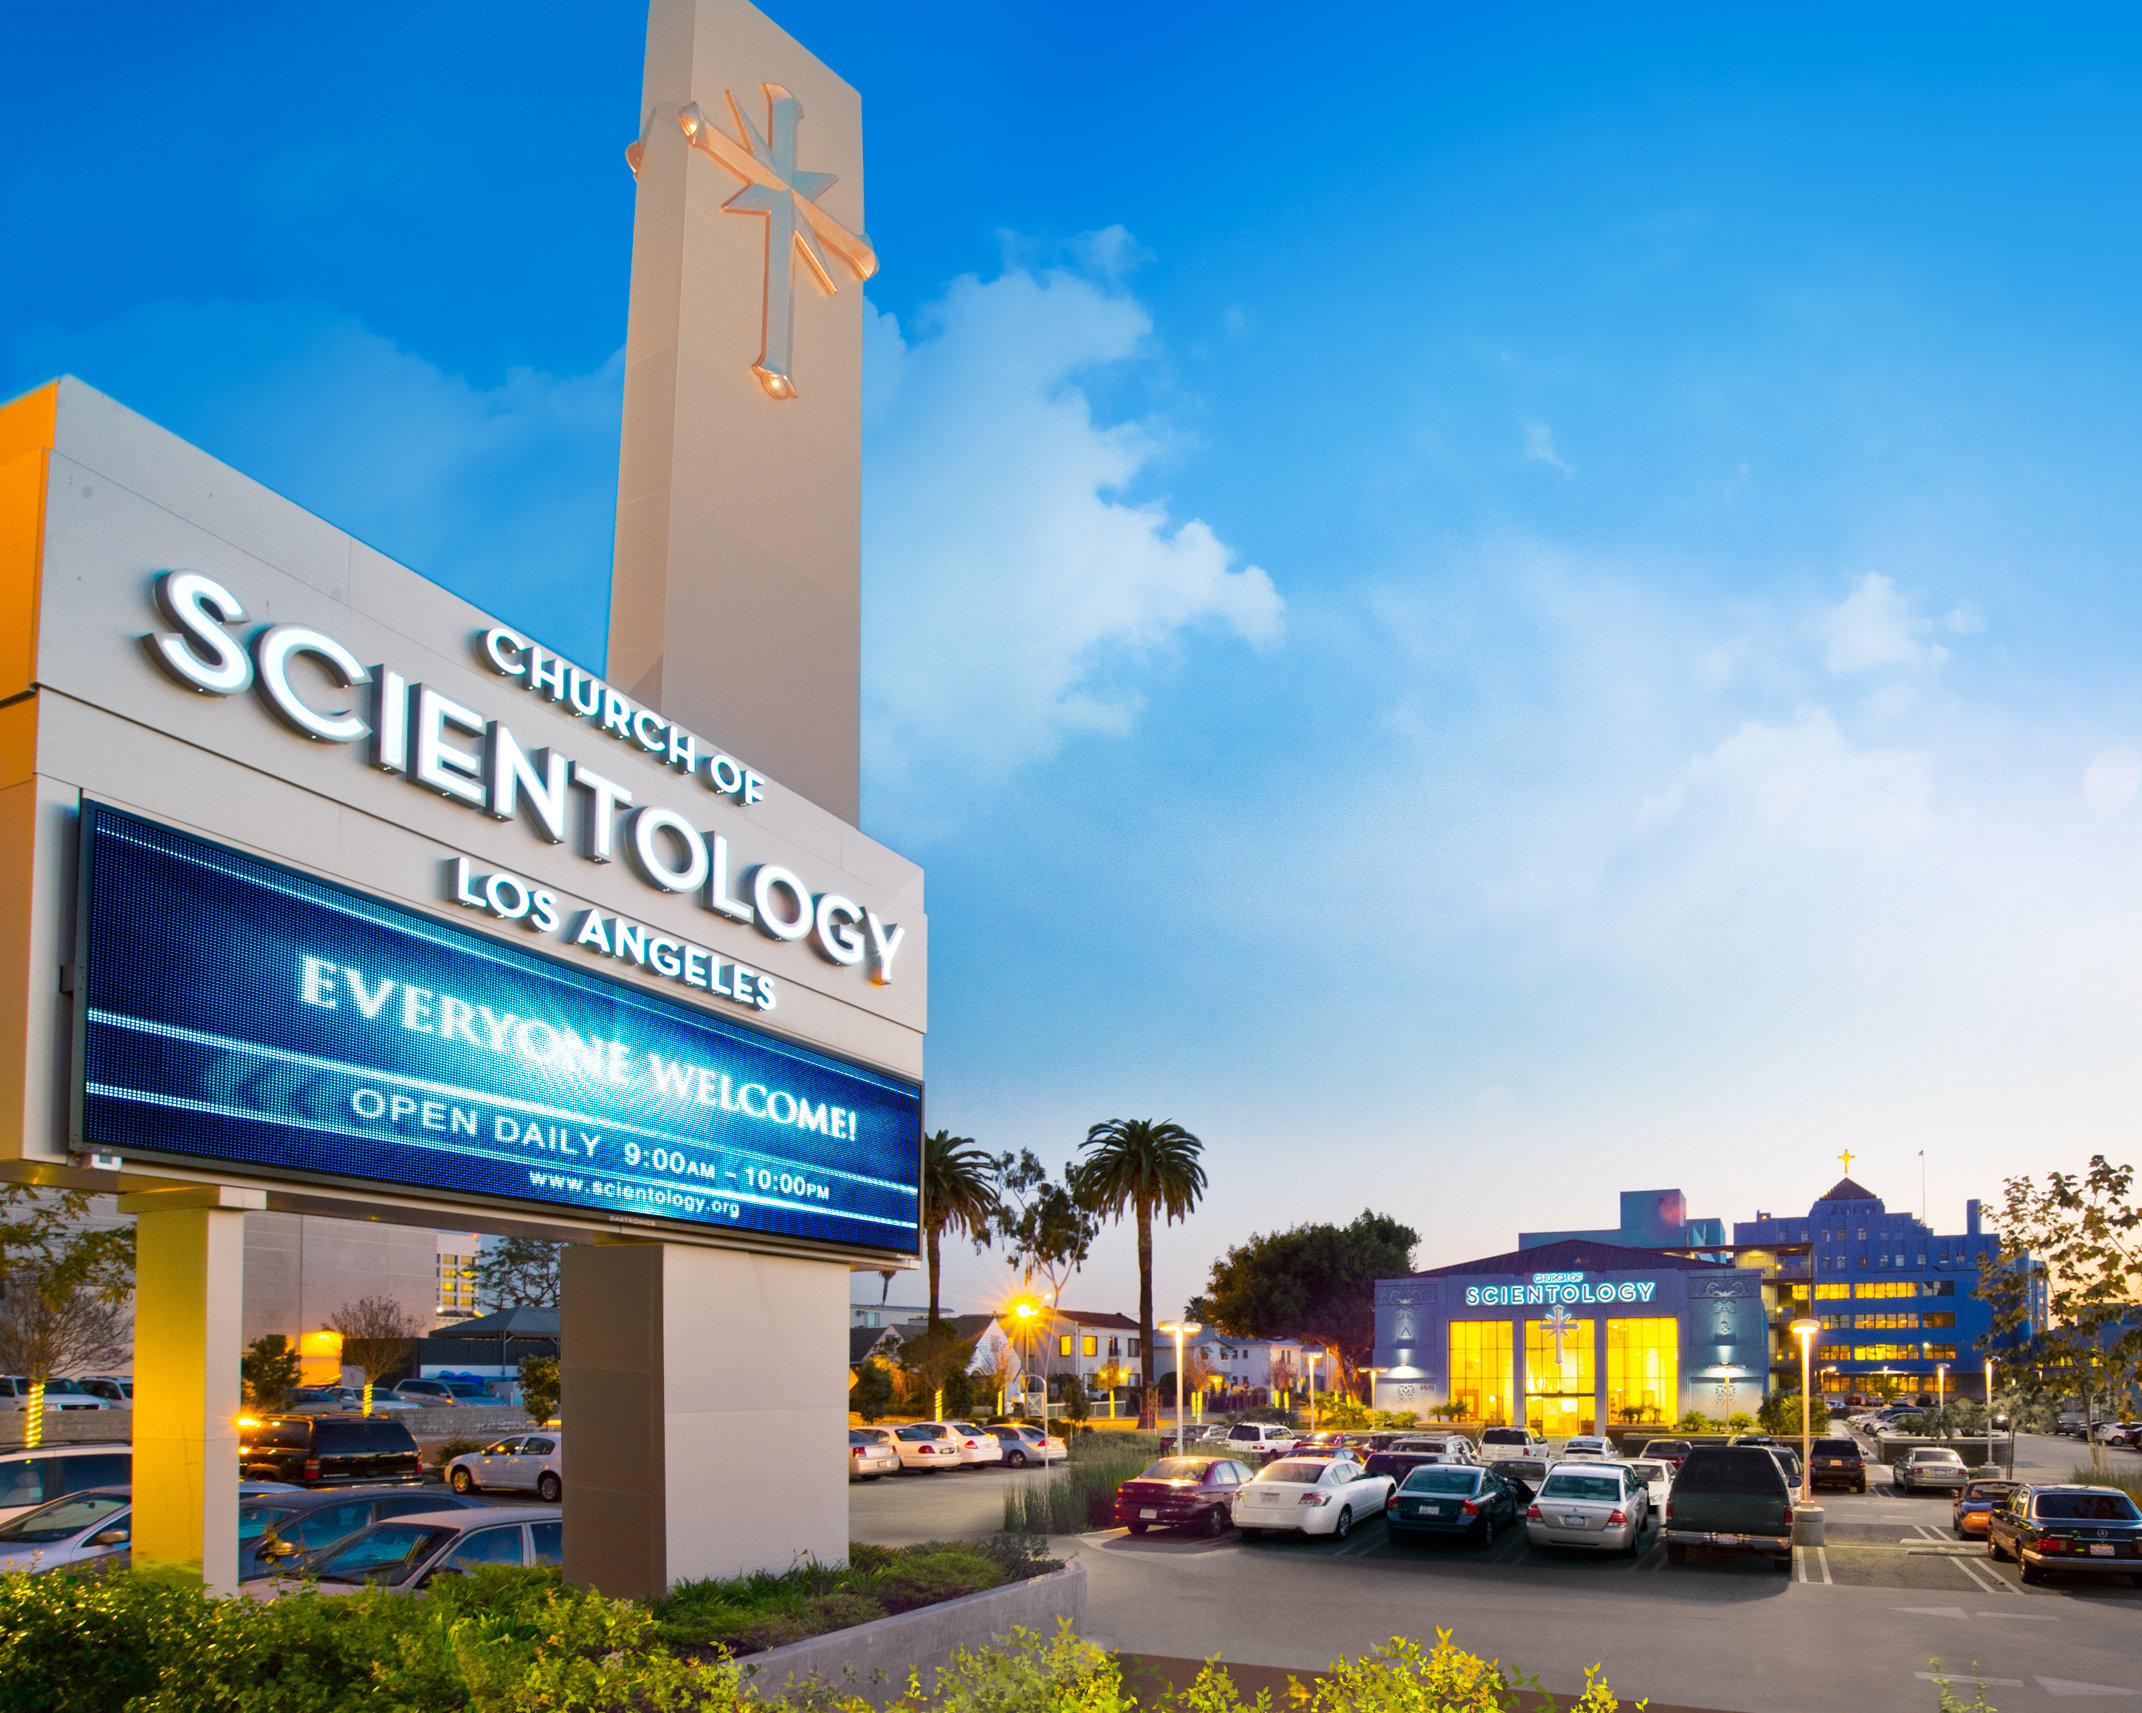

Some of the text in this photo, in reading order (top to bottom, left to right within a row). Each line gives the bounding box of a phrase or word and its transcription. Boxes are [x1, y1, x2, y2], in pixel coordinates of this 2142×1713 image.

[142, 569, 906, 985] SCIENTOLOGY
[479, 627, 765, 806] CHURCH OF
[450, 856, 778, 1012] LOS ANGELES
[299, 954, 858, 1142] EVERYONE WELCOME!
[352, 1088, 479, 1137] OPEN
[495, 1116, 602, 1159] DAILY
[530, 1169, 740, 1219] www.scientology.org
[1466, 1282, 1655, 1306] SCIENTOLOGY
